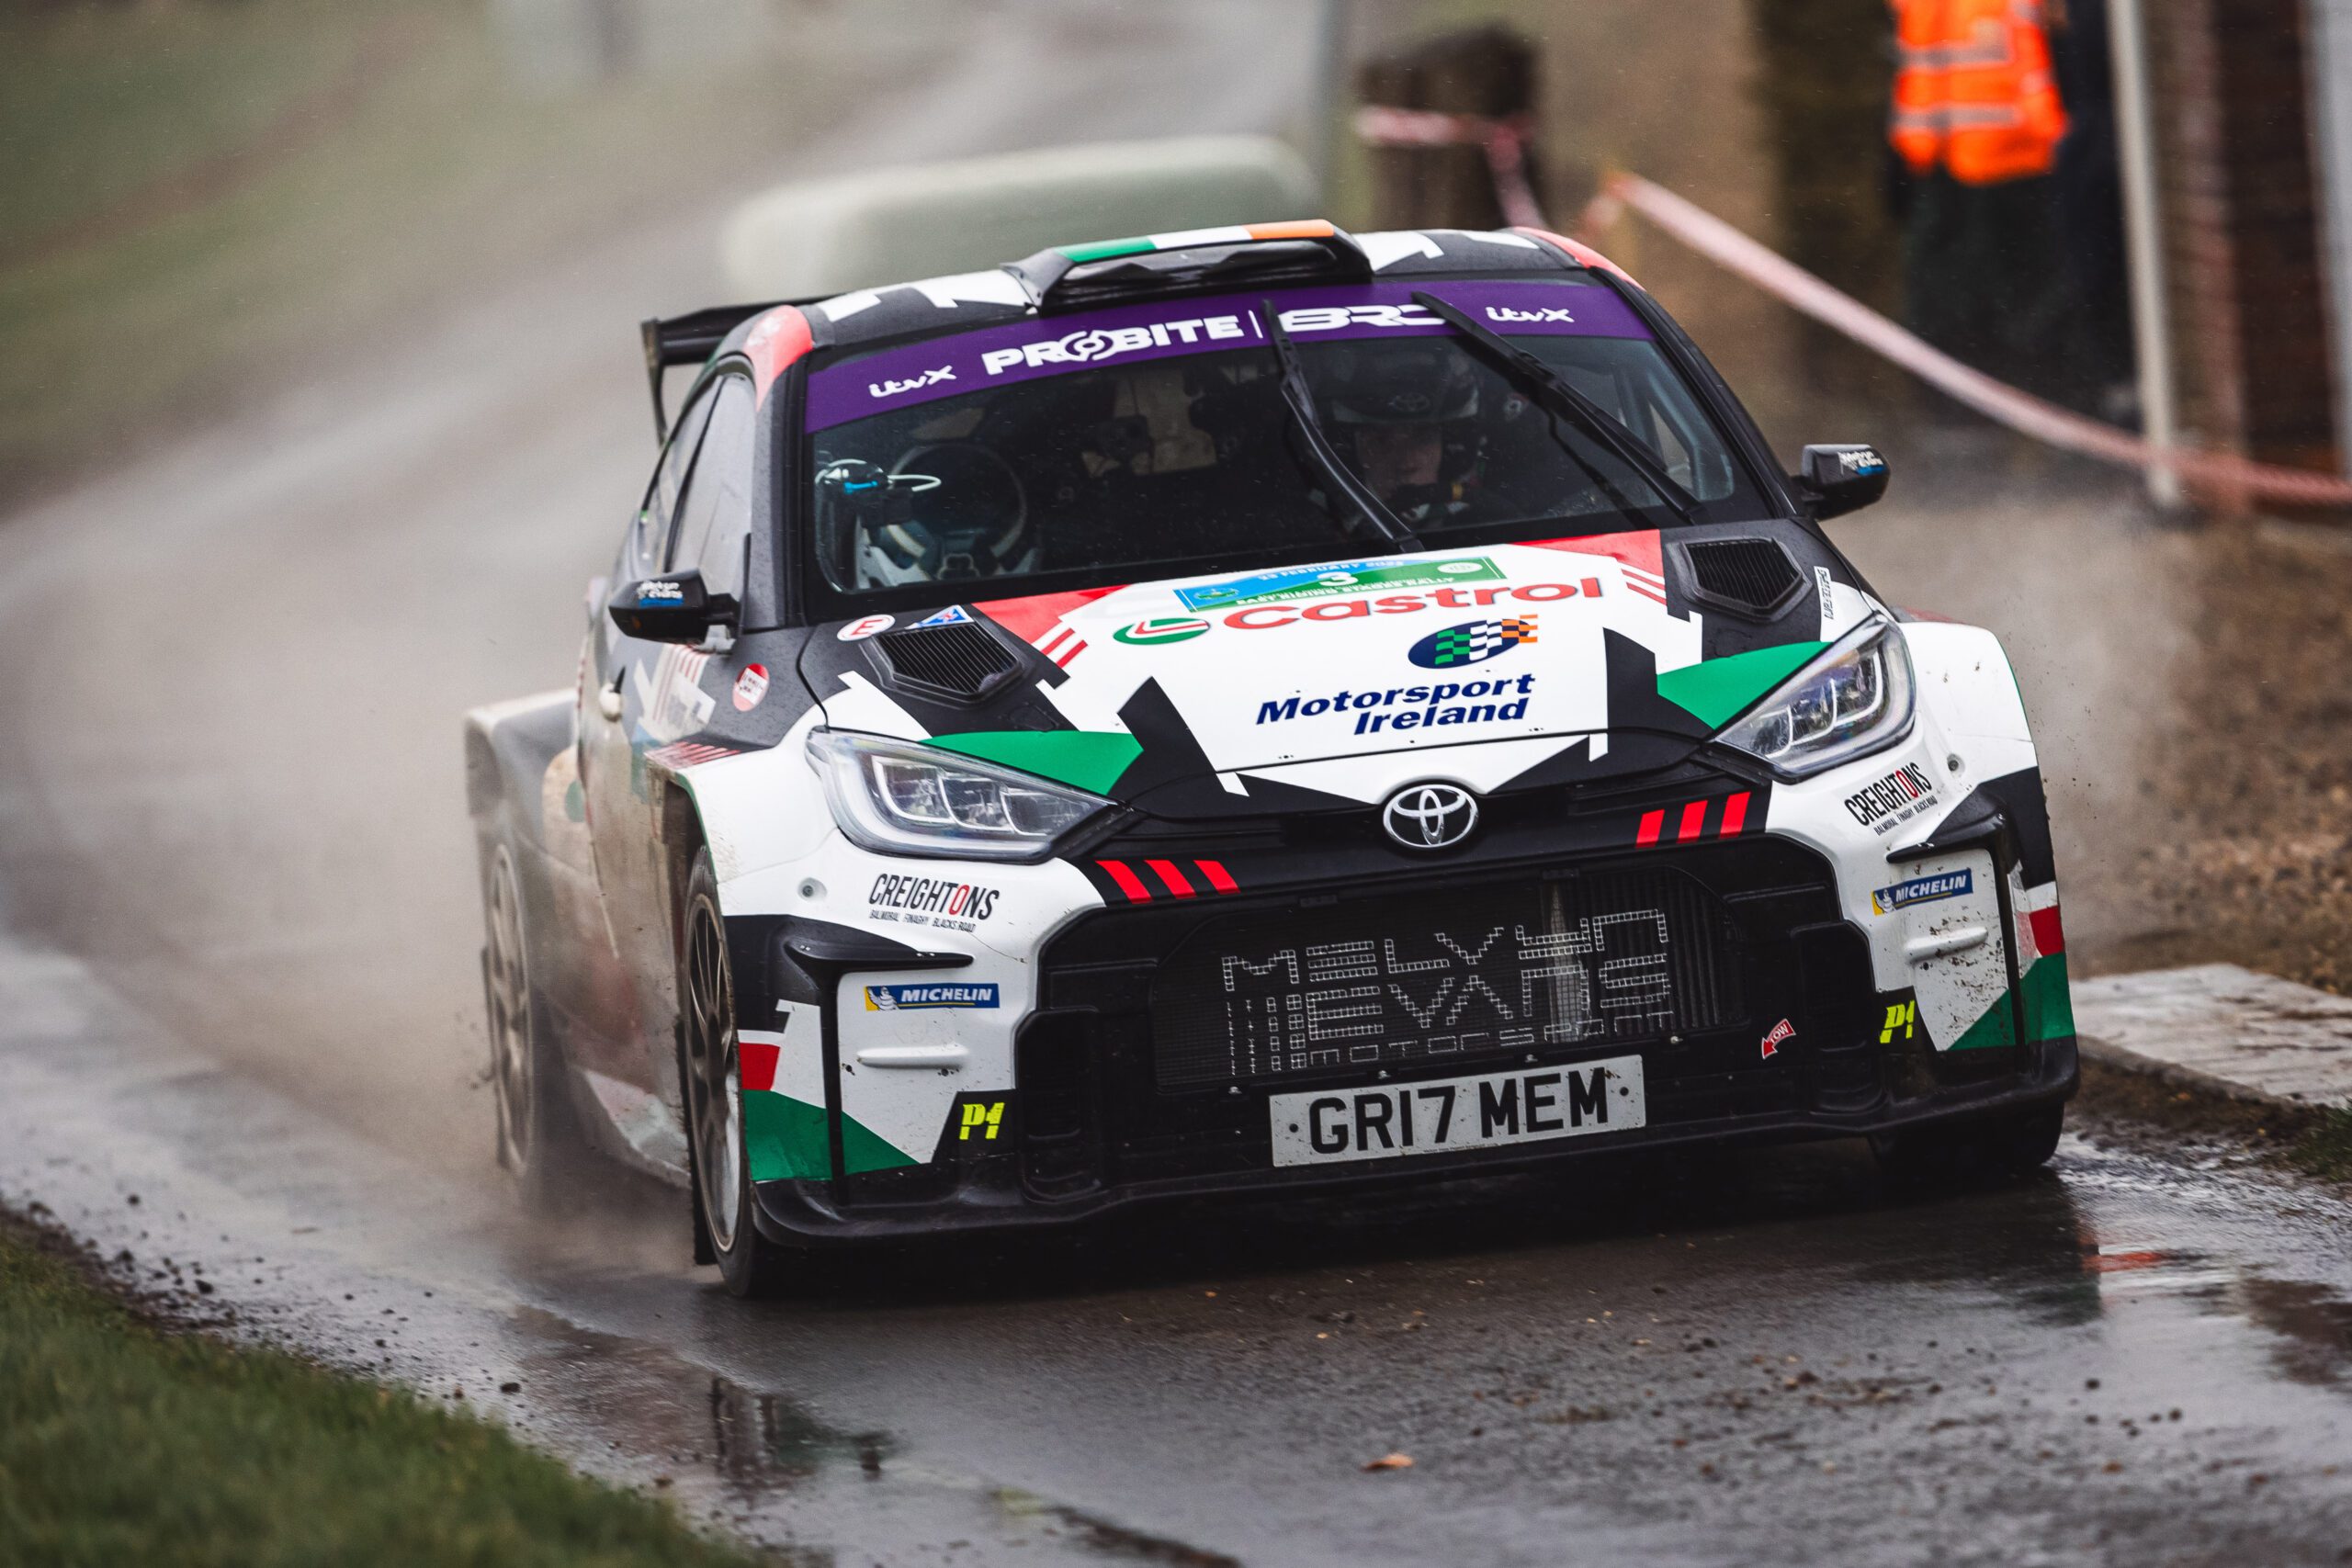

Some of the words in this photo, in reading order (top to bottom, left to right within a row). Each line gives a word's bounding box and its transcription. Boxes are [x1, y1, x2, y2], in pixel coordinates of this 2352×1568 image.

[981, 315, 1245, 376] PROBITE
[1279, 304, 1446, 332] BRC
[1281, 562, 1361, 577] FEBRUARY
[1317, 571, 1359, 587] 3
[1224, 577, 1602, 629] Castrol
[851, 618, 883, 636] E
[1255, 673, 1536, 726] Motorsport
[1353, 697, 1529, 735] Ireland
[1844, 761, 1932, 826] CREIGHTONS
[868, 874, 1001, 920] CREIGHTONS
[1895, 874, 1967, 902] MICHELIN
[901, 987, 993, 1002] MICHELIN
[1308, 1085, 1456, 1155] GR17
[1478, 1066, 1610, 1138] MEM
